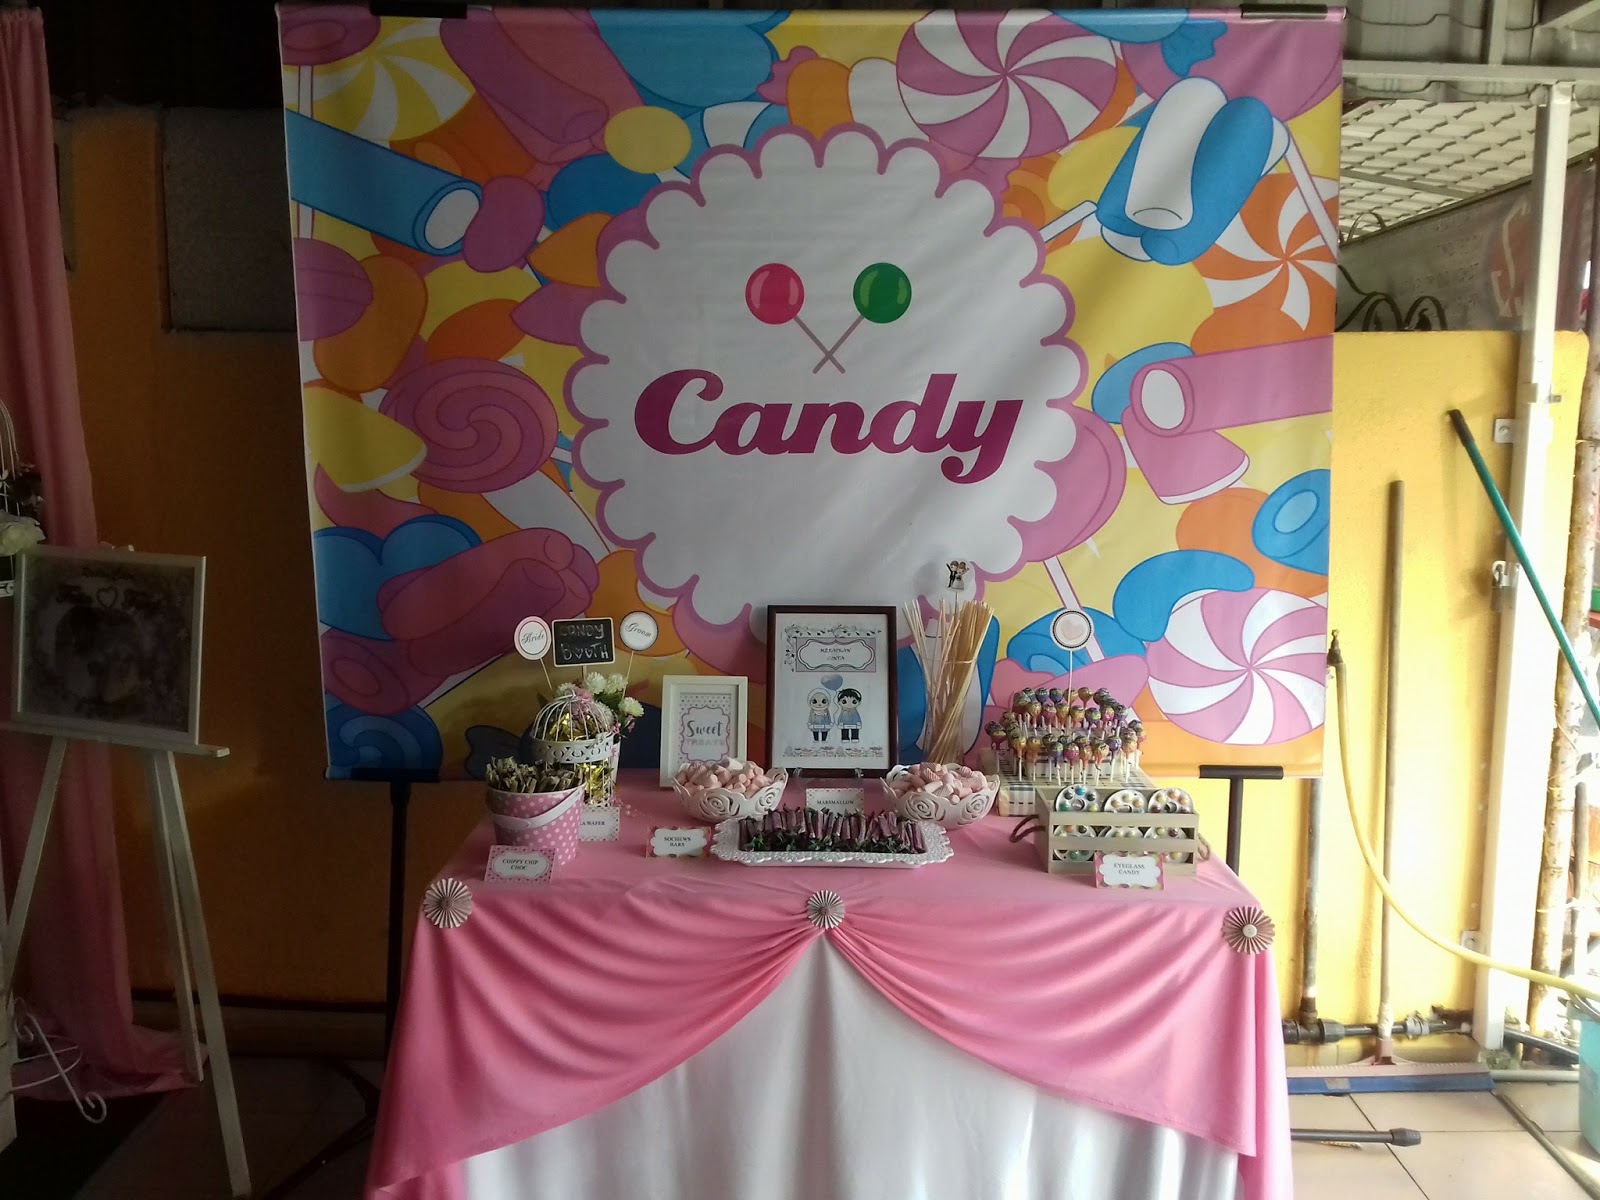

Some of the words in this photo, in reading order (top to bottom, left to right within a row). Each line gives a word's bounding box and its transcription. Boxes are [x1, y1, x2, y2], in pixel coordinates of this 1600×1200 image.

[634, 368, 1024, 485] Candy
[521, 629, 545, 644] Bride
[625, 622, 652, 637] Groom
[686, 720, 723, 738] Sweet
